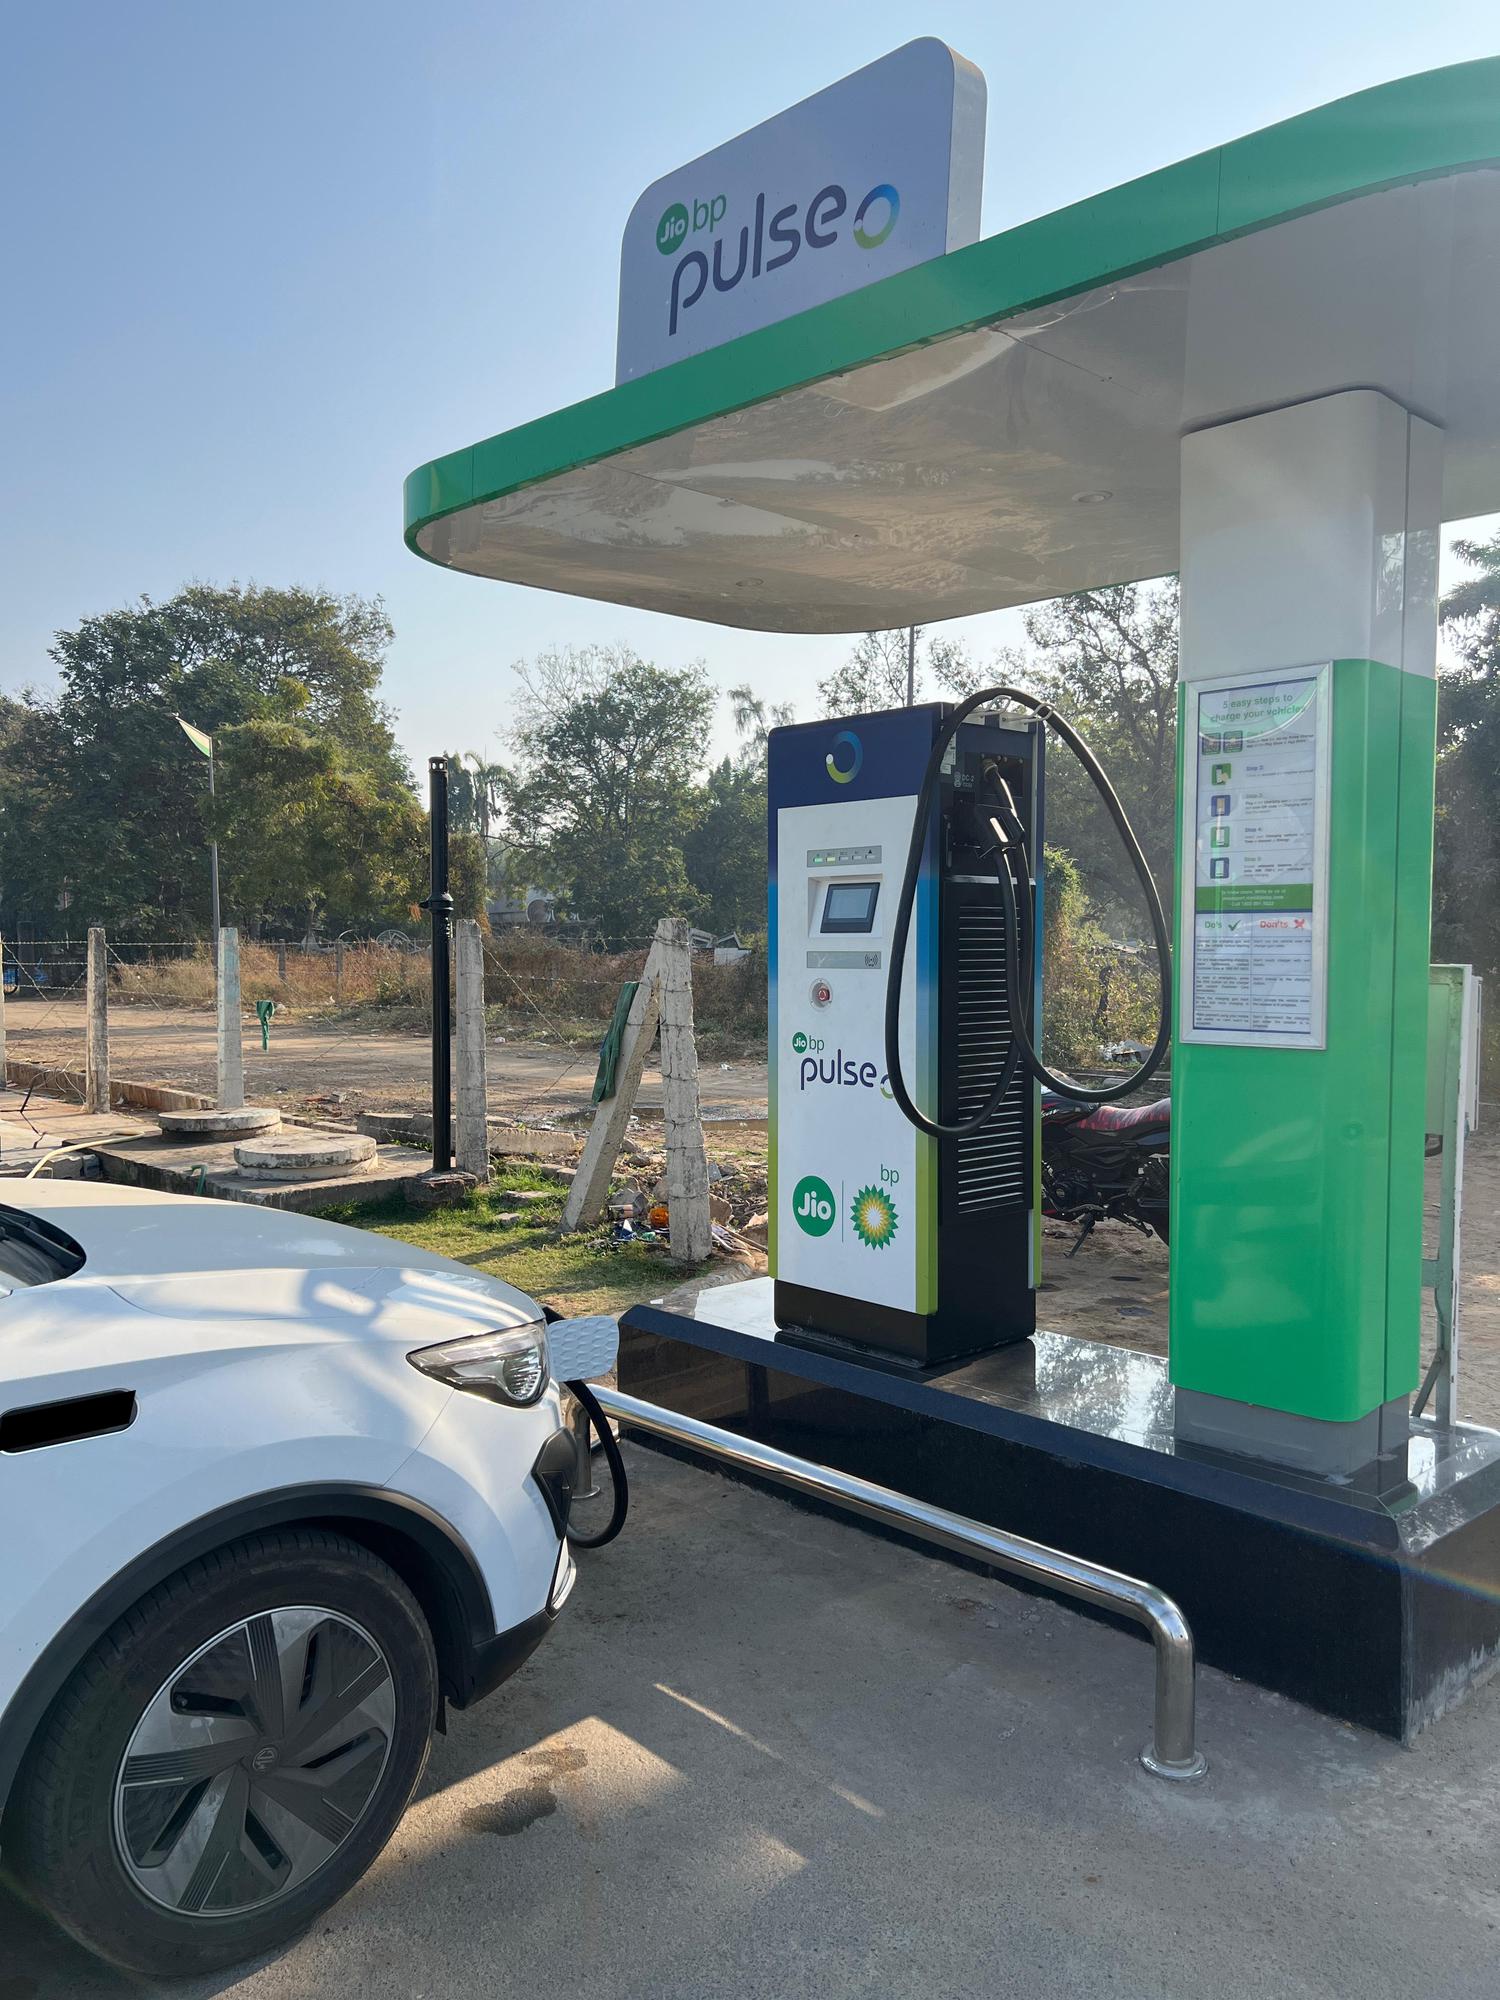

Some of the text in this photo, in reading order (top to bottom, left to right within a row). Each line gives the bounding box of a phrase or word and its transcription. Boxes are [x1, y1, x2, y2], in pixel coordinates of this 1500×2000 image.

[660, 193, 727, 243] Jio bp
[668, 184, 847, 337] pulse
[1230, 699, 1252, 709] easy
[1254, 695, 1280, 706] steps
[1283, 694, 1294, 702] to
[1210, 711, 1241, 722] charge
[1243, 709, 1265, 720] your
[794, 1035, 825, 1053] Jio bp
[800, 1048, 878, 1091] pulse
[880, 1164, 900, 1187] bp
[797, 1190, 832, 1221] Jio
